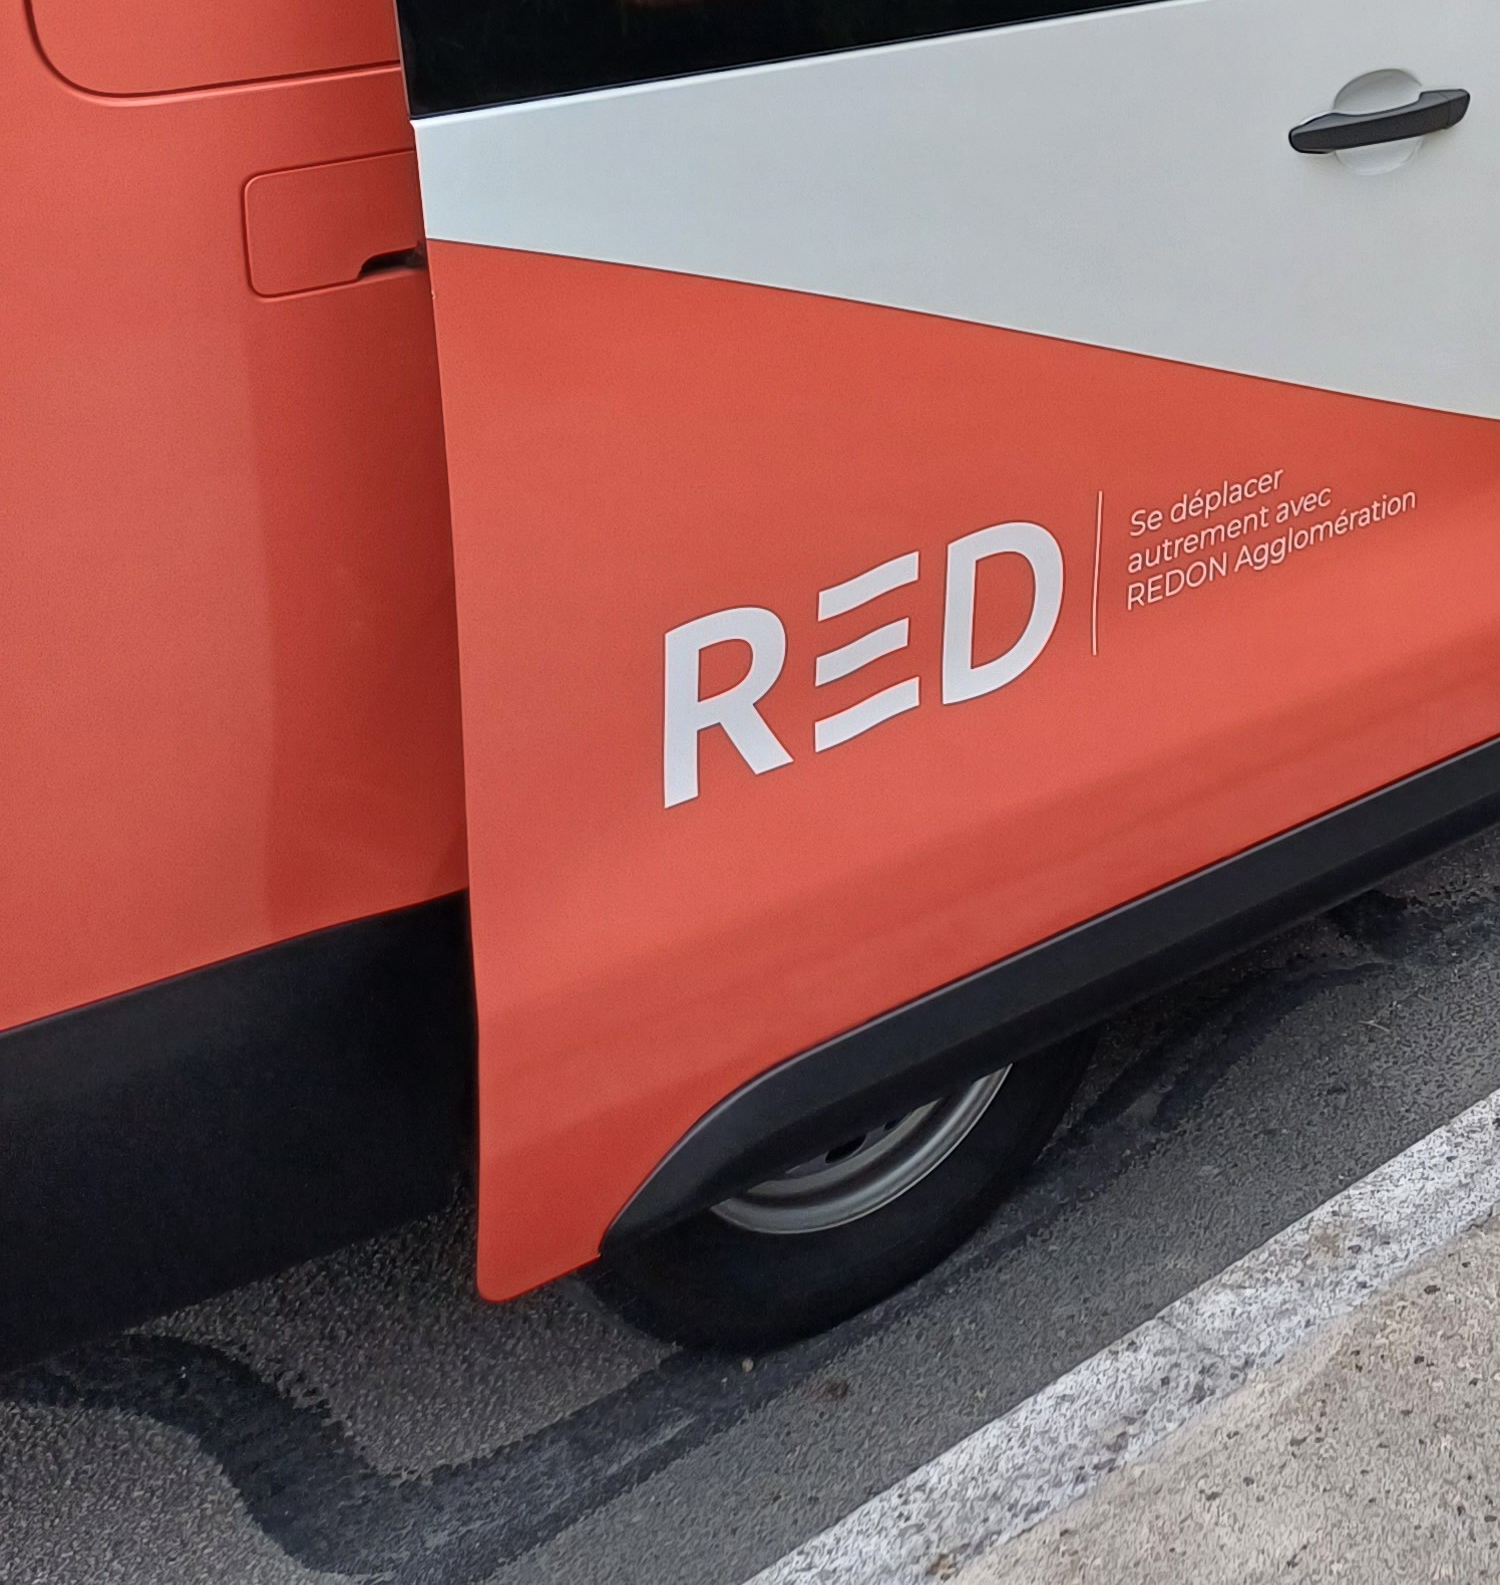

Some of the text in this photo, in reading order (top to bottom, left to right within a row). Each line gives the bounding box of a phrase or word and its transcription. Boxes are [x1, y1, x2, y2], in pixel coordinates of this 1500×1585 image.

[1127, 486, 1332, 574] autrement avec
[1127, 491, 1416, 611] REDON Agglomération
[1129, 469, 1284, 537] Se déplacer
[664, 521, 1064, 809] RED
